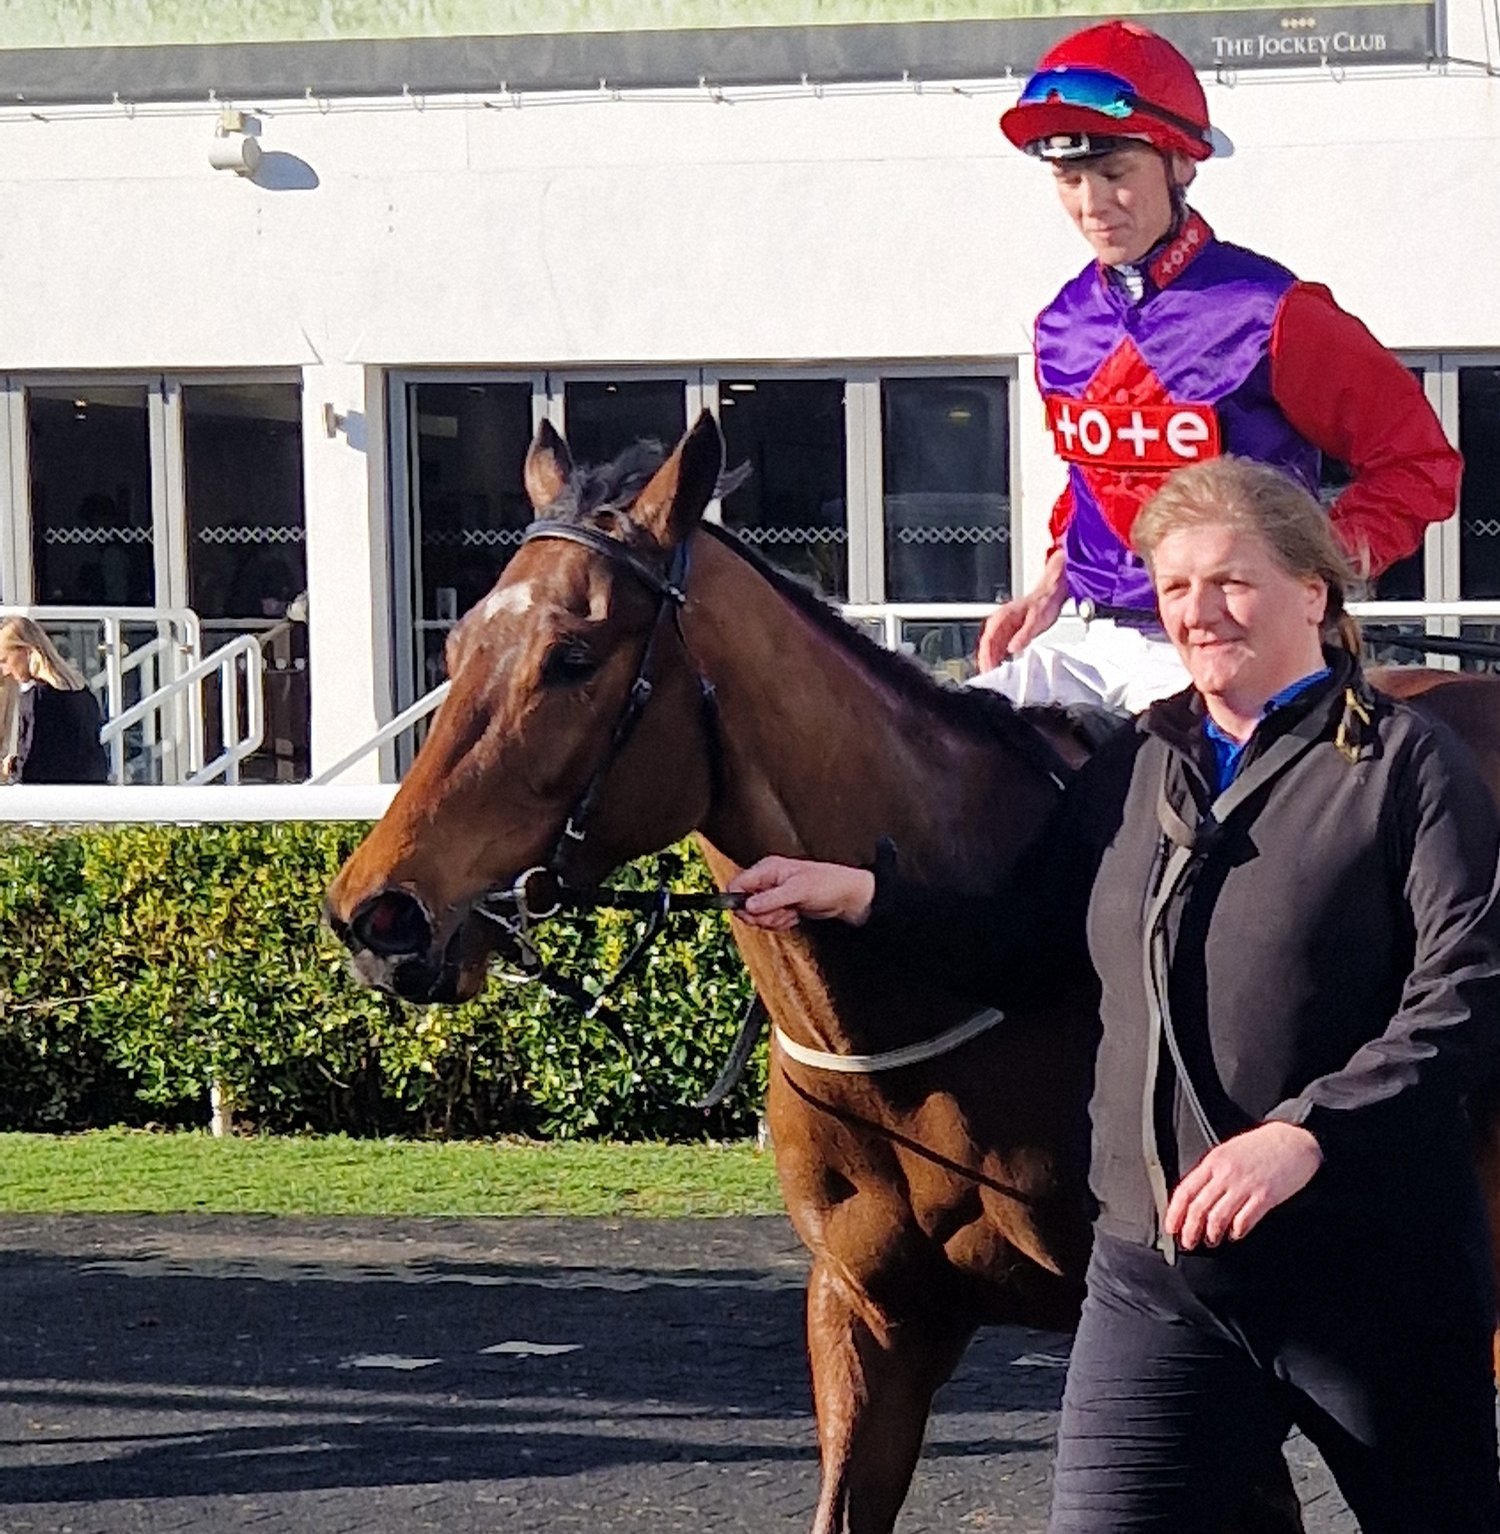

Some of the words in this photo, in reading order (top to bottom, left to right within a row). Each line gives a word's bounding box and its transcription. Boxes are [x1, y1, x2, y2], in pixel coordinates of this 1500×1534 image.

[1211, 36, 1253, 57] THE
[1257, 34, 1331, 59] JOCKEY
[1333, 31, 1387, 52] CLUB
